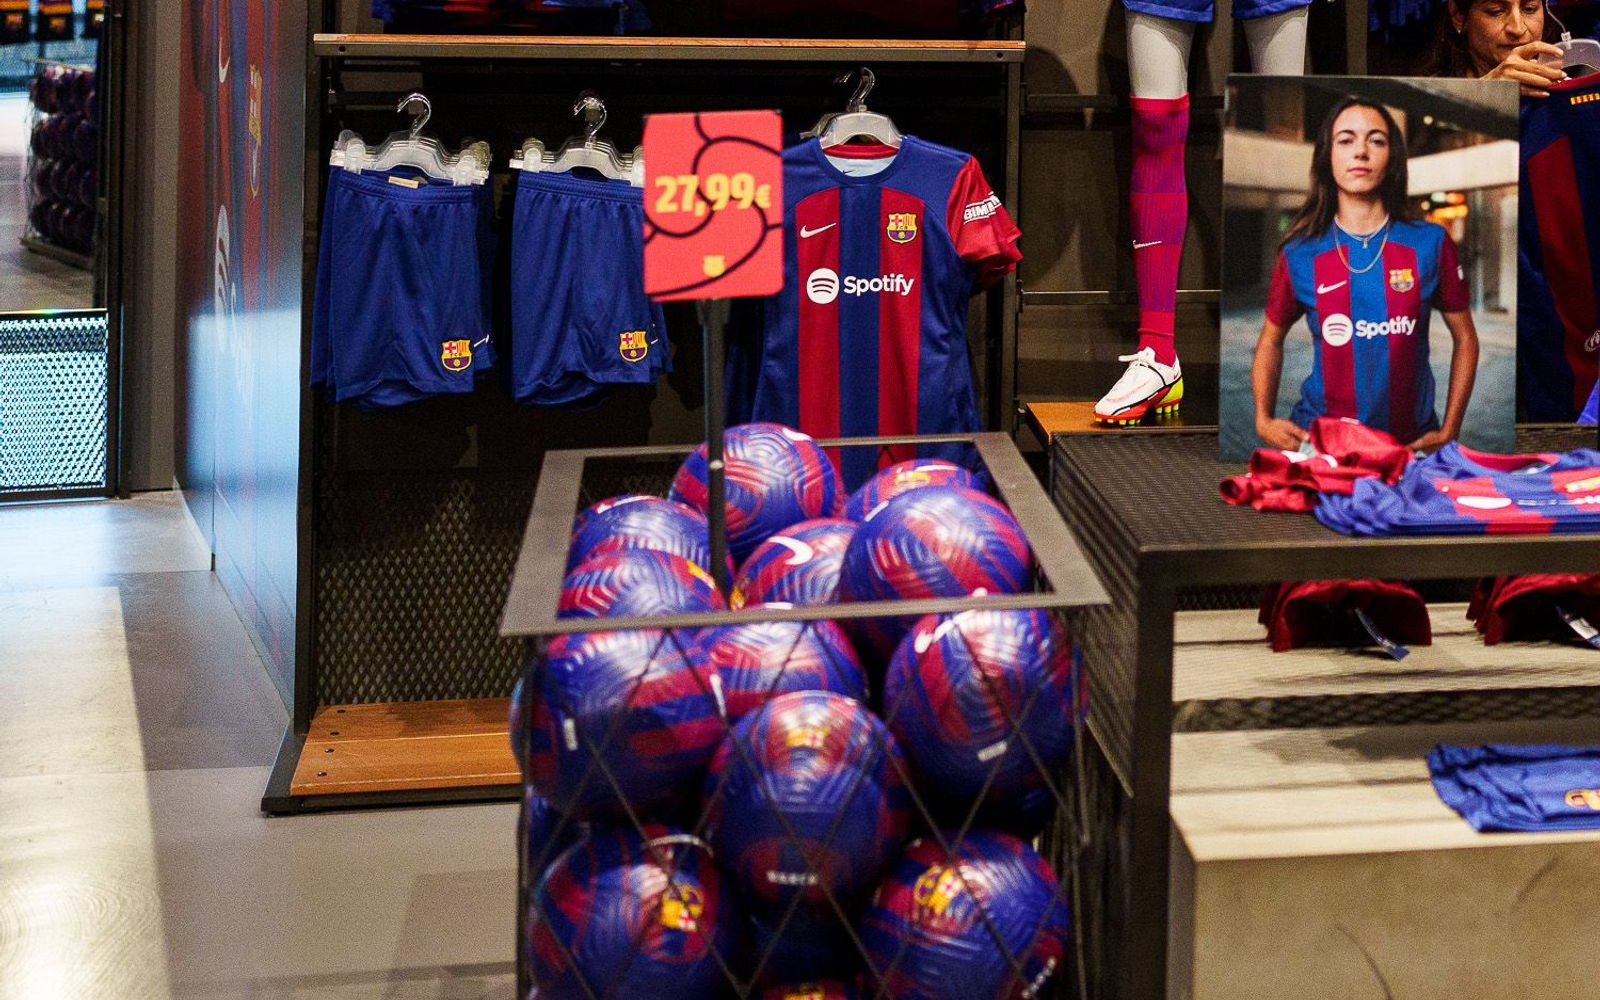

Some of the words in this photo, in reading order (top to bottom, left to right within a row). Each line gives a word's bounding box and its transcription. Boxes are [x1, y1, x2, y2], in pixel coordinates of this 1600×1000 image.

[655, 172, 772, 217] 27,99€
[843, 273, 915, 296] Spotify
[1355, 315, 1417, 340] Spotify
